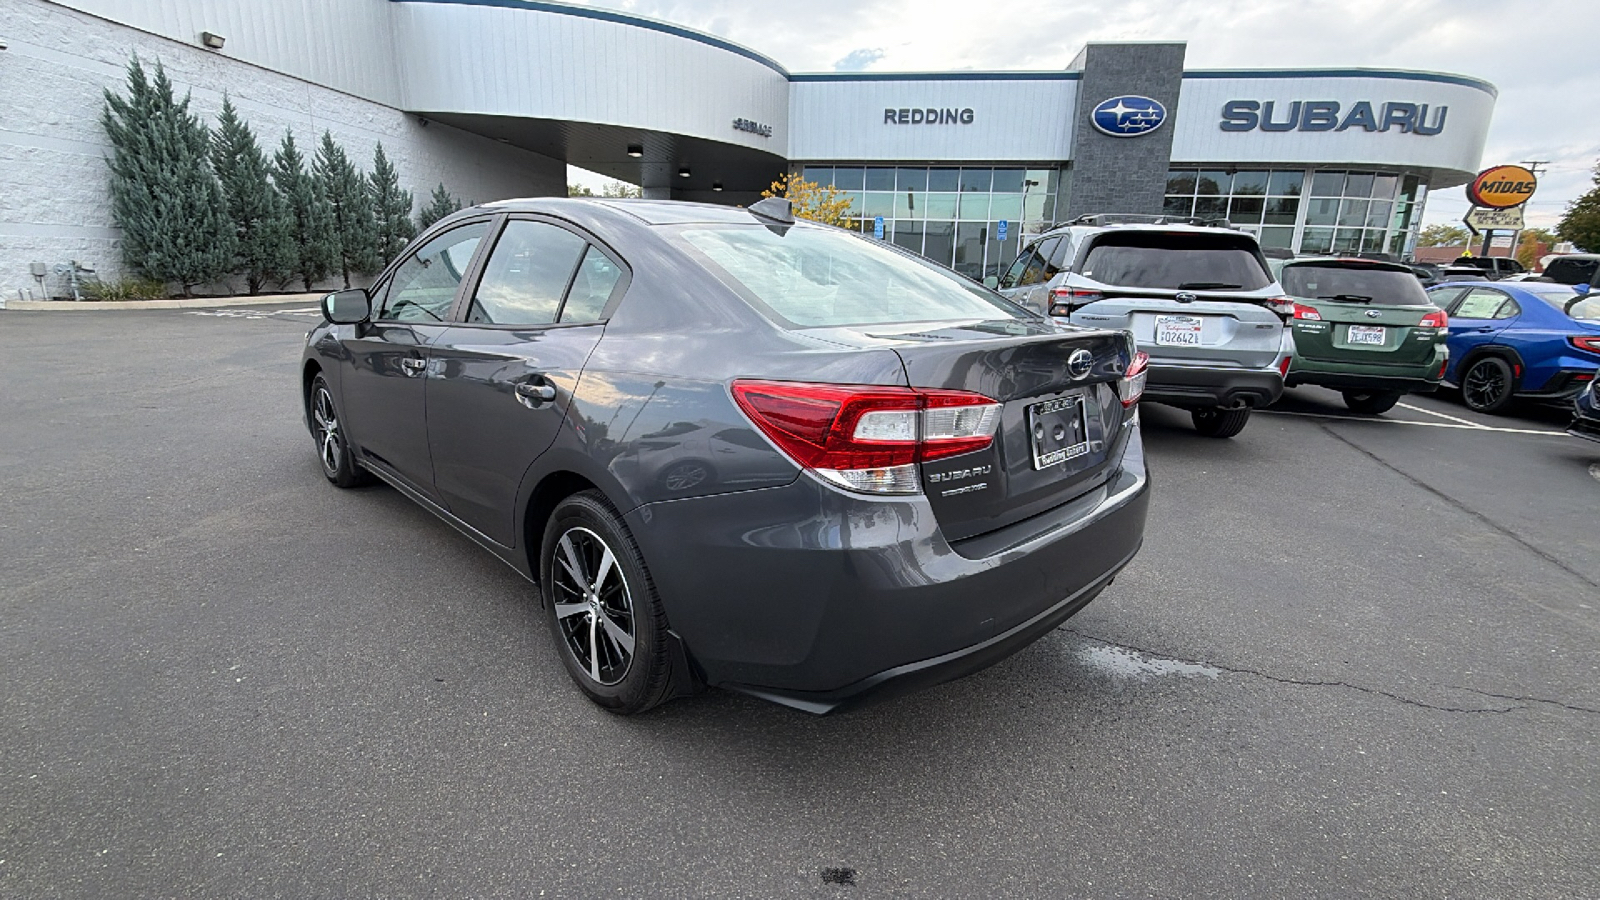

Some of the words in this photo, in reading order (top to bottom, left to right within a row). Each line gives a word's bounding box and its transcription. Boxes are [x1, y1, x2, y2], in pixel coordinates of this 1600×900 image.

[884, 108, 974, 125] REDDING
[1220, 100, 1448, 136] SUBARU
[1479, 181, 1536, 194] MIDAS
[1165, 331, 1194, 344] 02642
[929, 464, 991, 482] SUBARU
